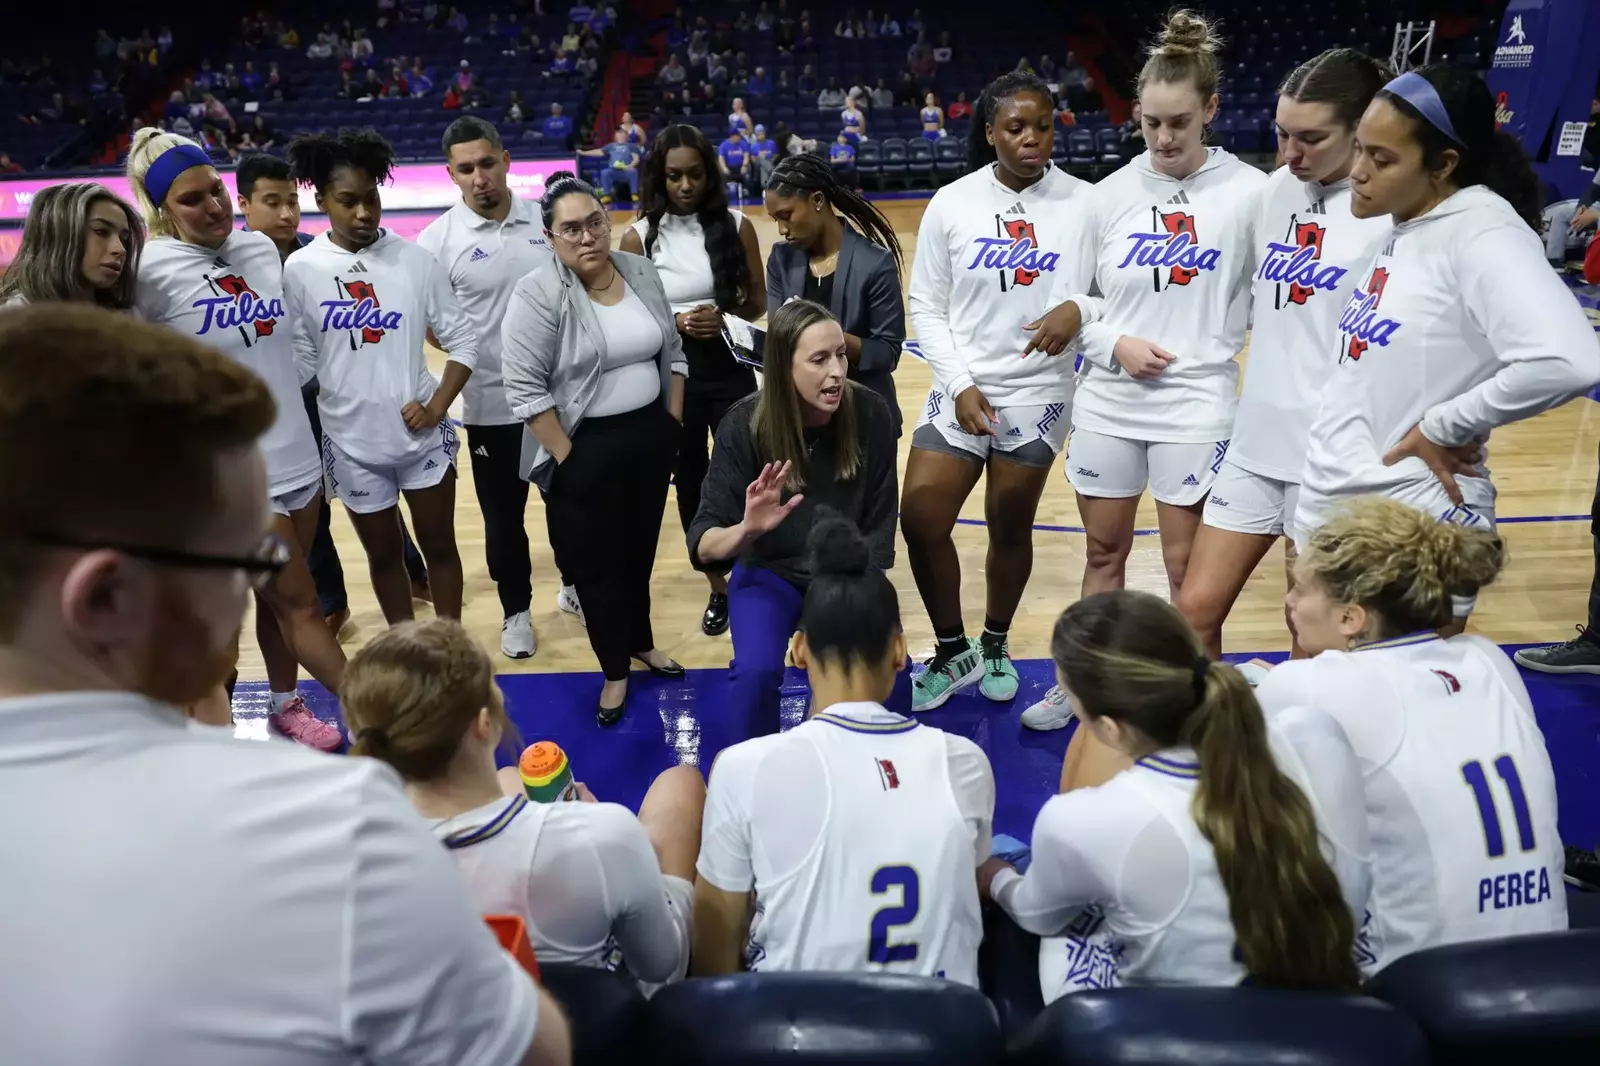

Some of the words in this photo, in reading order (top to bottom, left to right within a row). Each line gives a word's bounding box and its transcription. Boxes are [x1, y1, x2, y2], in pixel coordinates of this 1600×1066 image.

[1495, 45, 1534, 55] ADVANCED
[1495, 102, 1515, 124] lsa
[967, 237, 1060, 272] Tulsa
[1117, 232, 1221, 272] Tulsa
[1258, 242, 1348, 291] Tulsa
[192, 291, 285, 335] Tulsa
[319, 298, 403, 333] Tulsa
[1338, 288, 1402, 347] Tulsa
[1076, 467, 1100, 478] Tulsa
[349, 490, 370, 498] Tulsa
[1209, 495, 1229, 507] Tulsa
[1461, 752, 1537, 859] 11
[1478, 866, 1552, 914] PEREA
[867, 863, 921, 965] 2
